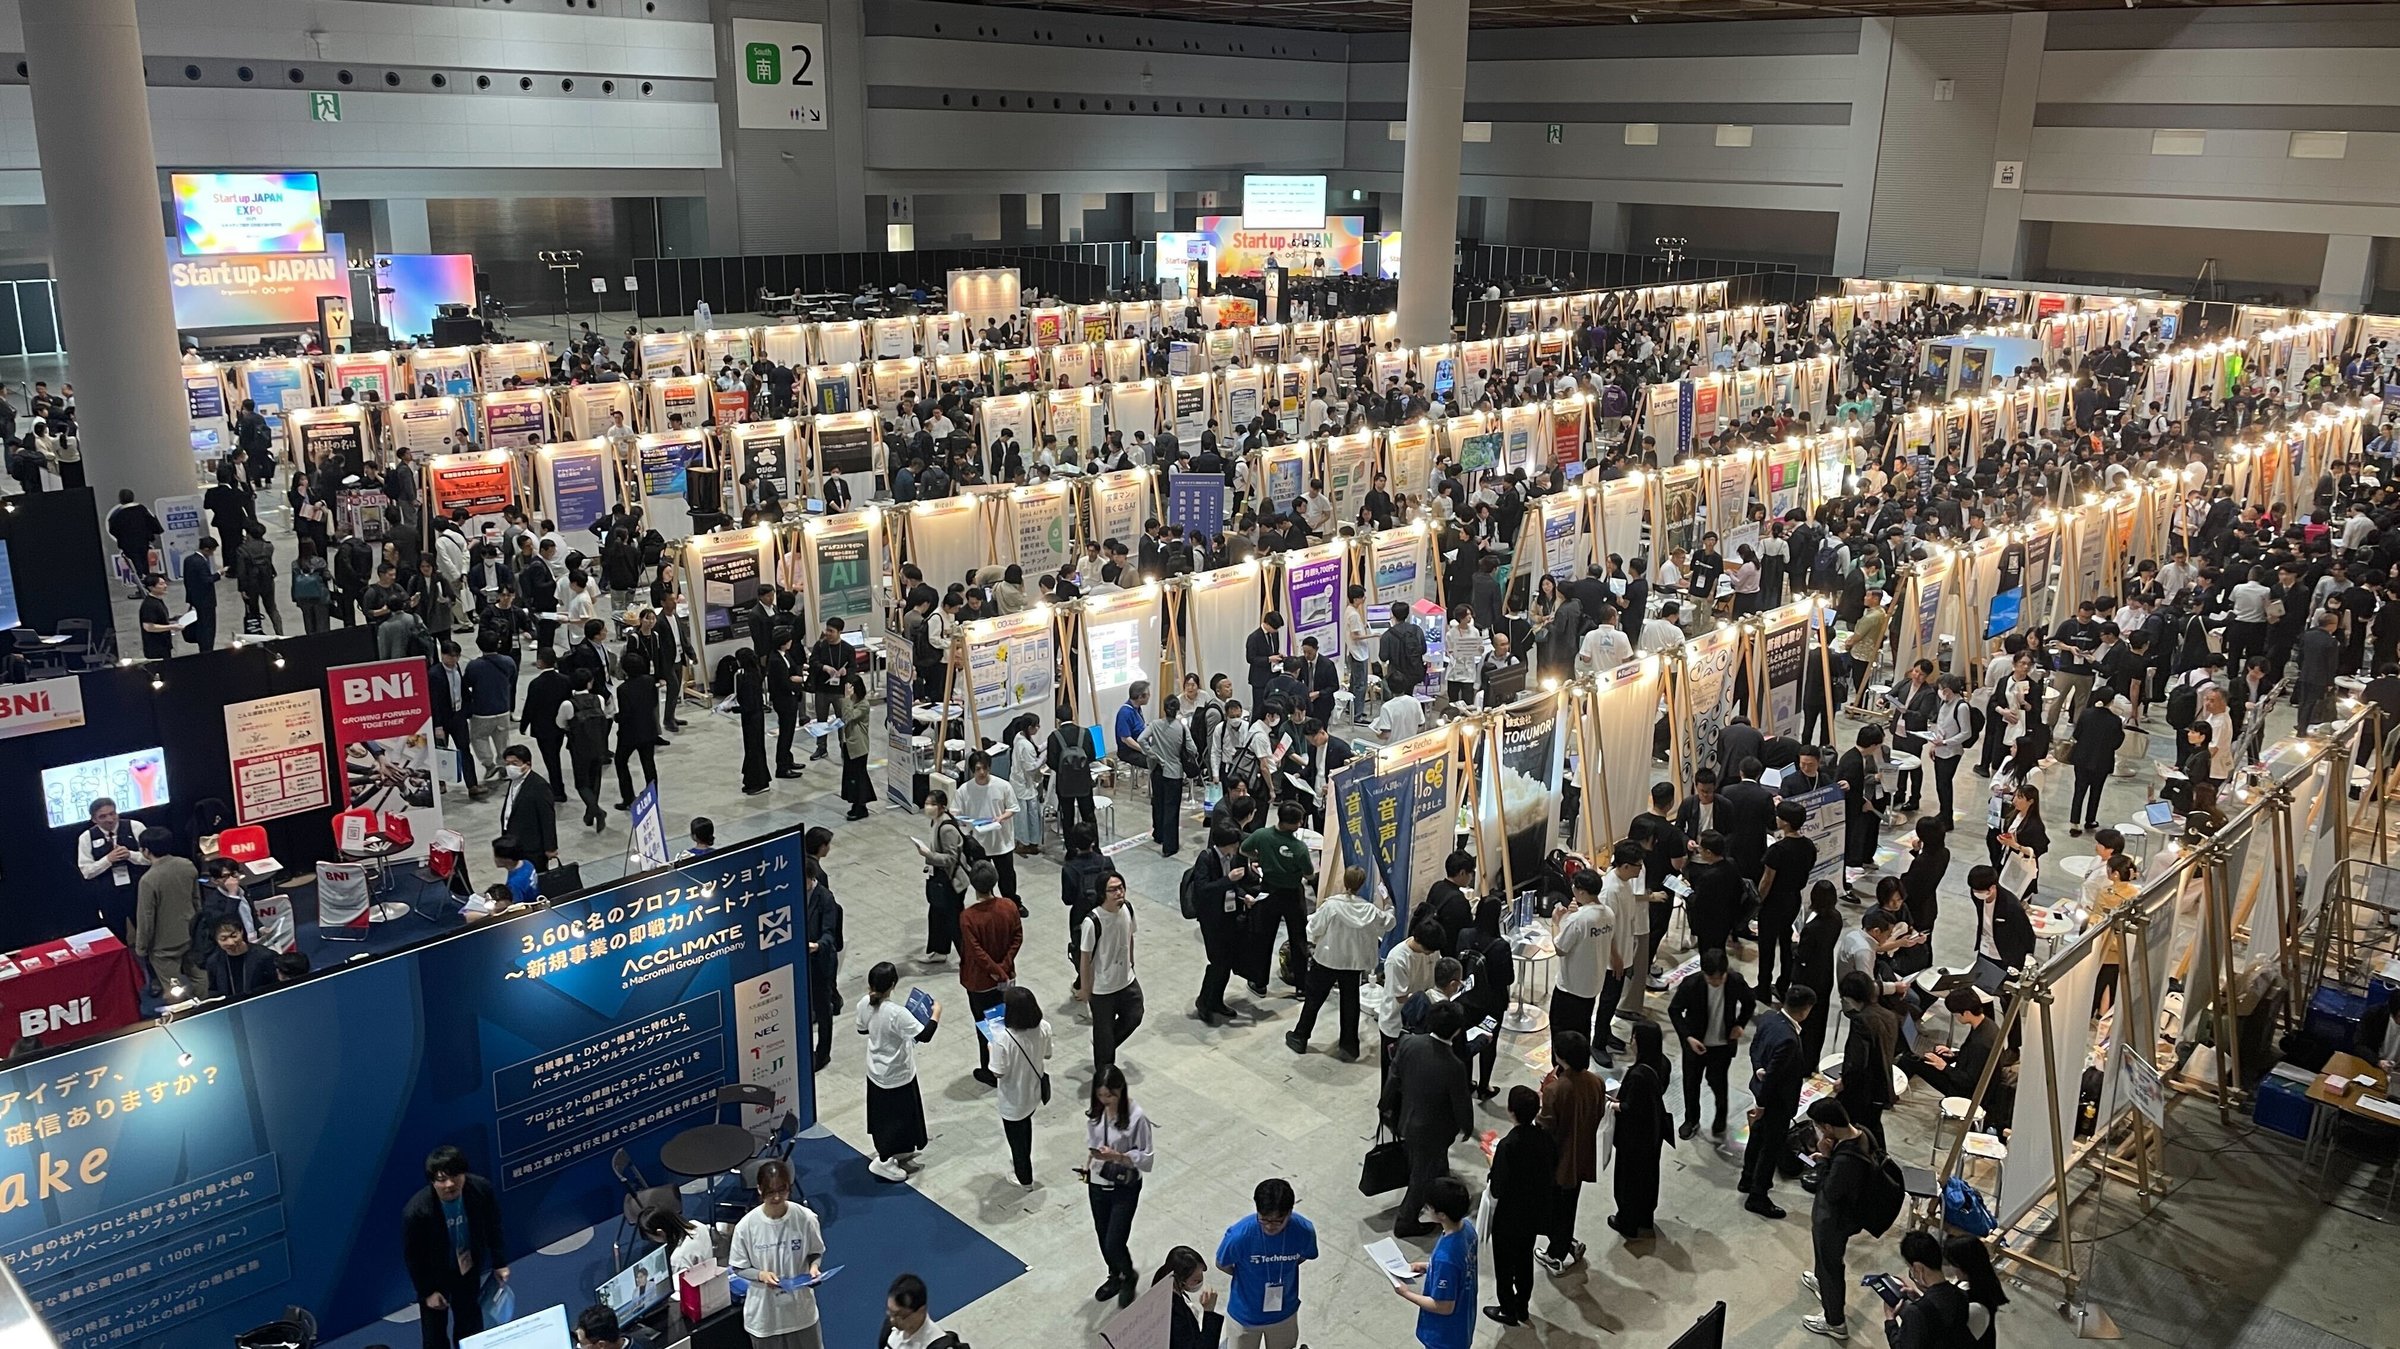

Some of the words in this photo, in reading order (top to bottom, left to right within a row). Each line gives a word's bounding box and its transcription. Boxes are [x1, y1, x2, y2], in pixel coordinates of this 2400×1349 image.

[753, 47, 773, 57] South
[756, 58, 771, 80] 南
[791, 45, 813, 86] 2
[251, 192, 283, 202] JAPAN
[236, 205, 263, 215] EXPO
[262, 258, 336, 281] JAPAN
[333, 316, 344, 330] Y
[349, 375, 378, 391] 本音
[829, 560, 858, 589] AI
[342, 714, 380, 725] GROWING
[381, 708, 422, 721] FORWARD
[362, 718, 404, 730] TOGETHER
[1505, 714, 1532, 728] 株式会社
[1504, 717, 1555, 744] TOKUMORI
[1413, 737, 1432, 750] Recho
[1345, 791, 1364, 857] 音声A
[1378, 797, 1398, 864] 音声AI
[622, 981, 628, 990] a
[629, 964, 675, 987] Macromill
[676, 955, 705, 972] Group
[705, 940, 746, 964] company
[753, 1008, 779, 1024] PARCO
[754, 1023, 780, 1039] NEC
[532, 1024, 691, 1089] バーチャルコンサルティングファーム
[771, 1056, 785, 1074] JT
[4, 1066, 219, 1148] 確信ありますか？
[13, 1189, 250, 1275] ープンイノベーションプラットフォーム
